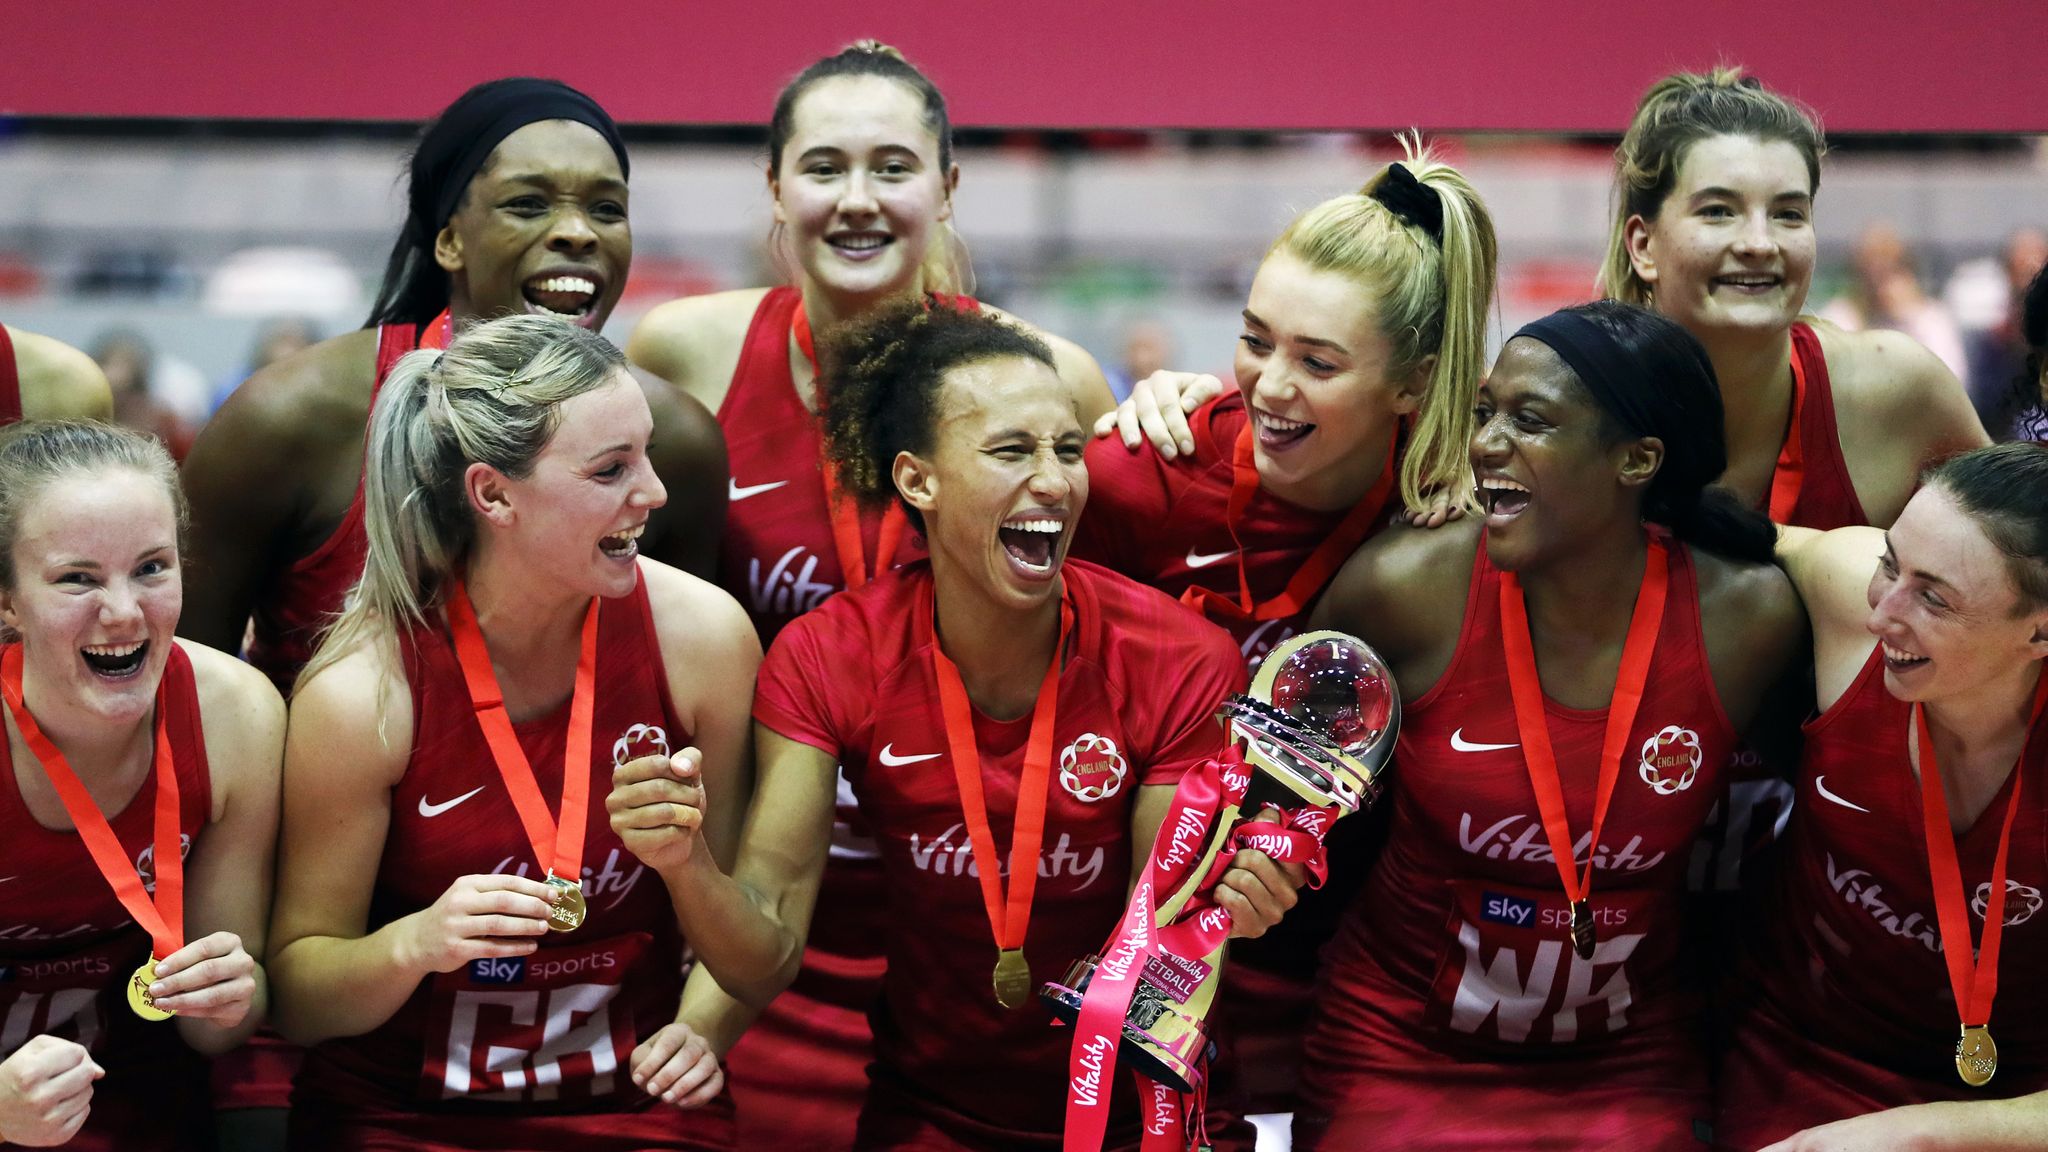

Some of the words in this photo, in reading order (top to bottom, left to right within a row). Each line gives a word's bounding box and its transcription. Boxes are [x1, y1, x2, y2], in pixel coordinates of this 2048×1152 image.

[1077, 761, 1109, 775] ENGLAND
[1657, 753, 1689, 768] ENGLAND
[1157, 806, 1207, 872] Vitality
[1487, 898, 1532, 925] sky
[1541, 906, 1628, 928] sprts
[20, 955, 111, 985] sports
[476, 958, 521, 983] sky
[530, 950, 616, 979] sports
[443, 983, 622, 1101] GA
[1071, 1034, 1114, 1107] Vitality
